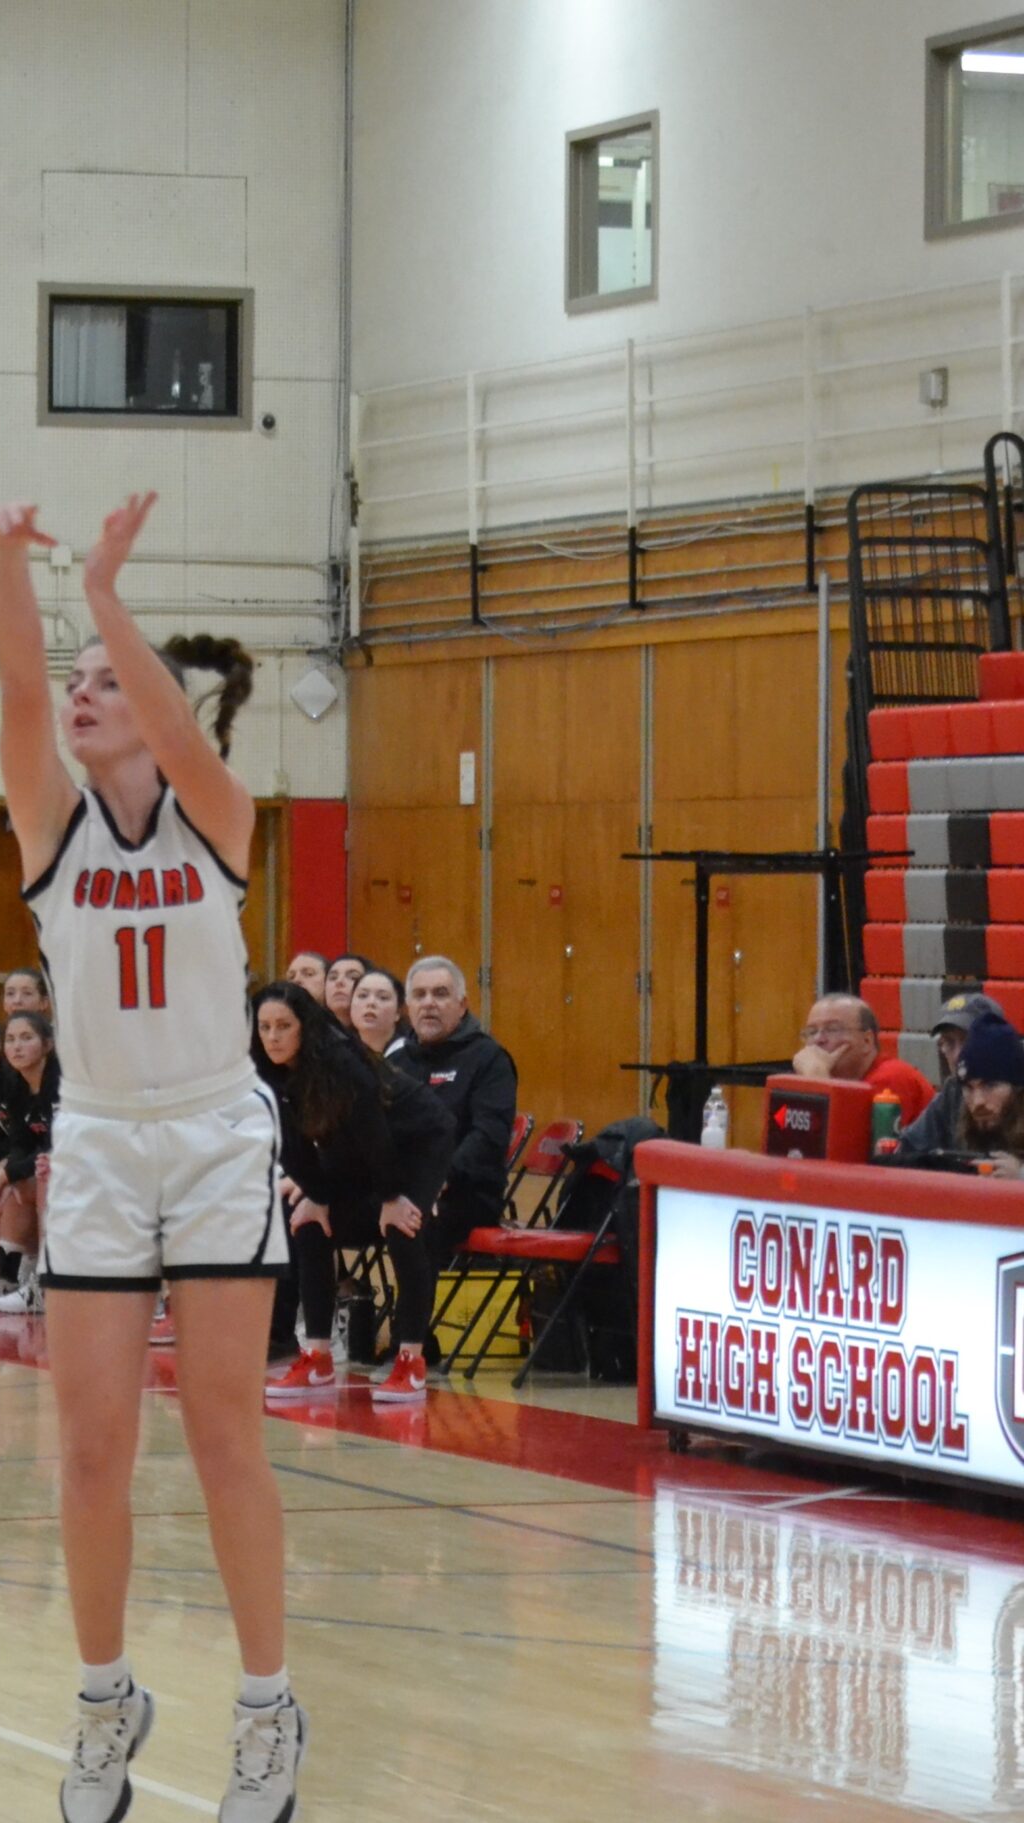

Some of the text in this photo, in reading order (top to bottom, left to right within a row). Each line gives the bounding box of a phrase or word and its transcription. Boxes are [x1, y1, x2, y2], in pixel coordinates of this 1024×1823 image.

[73, 862, 205, 911] CONARD
[114, 924, 167, 1010] 11
[784, 1108, 810, 1131] POSS
[730, 1210, 909, 1335] CONARD
[675, 1307, 970, 1462] HIGH SCHOOL
